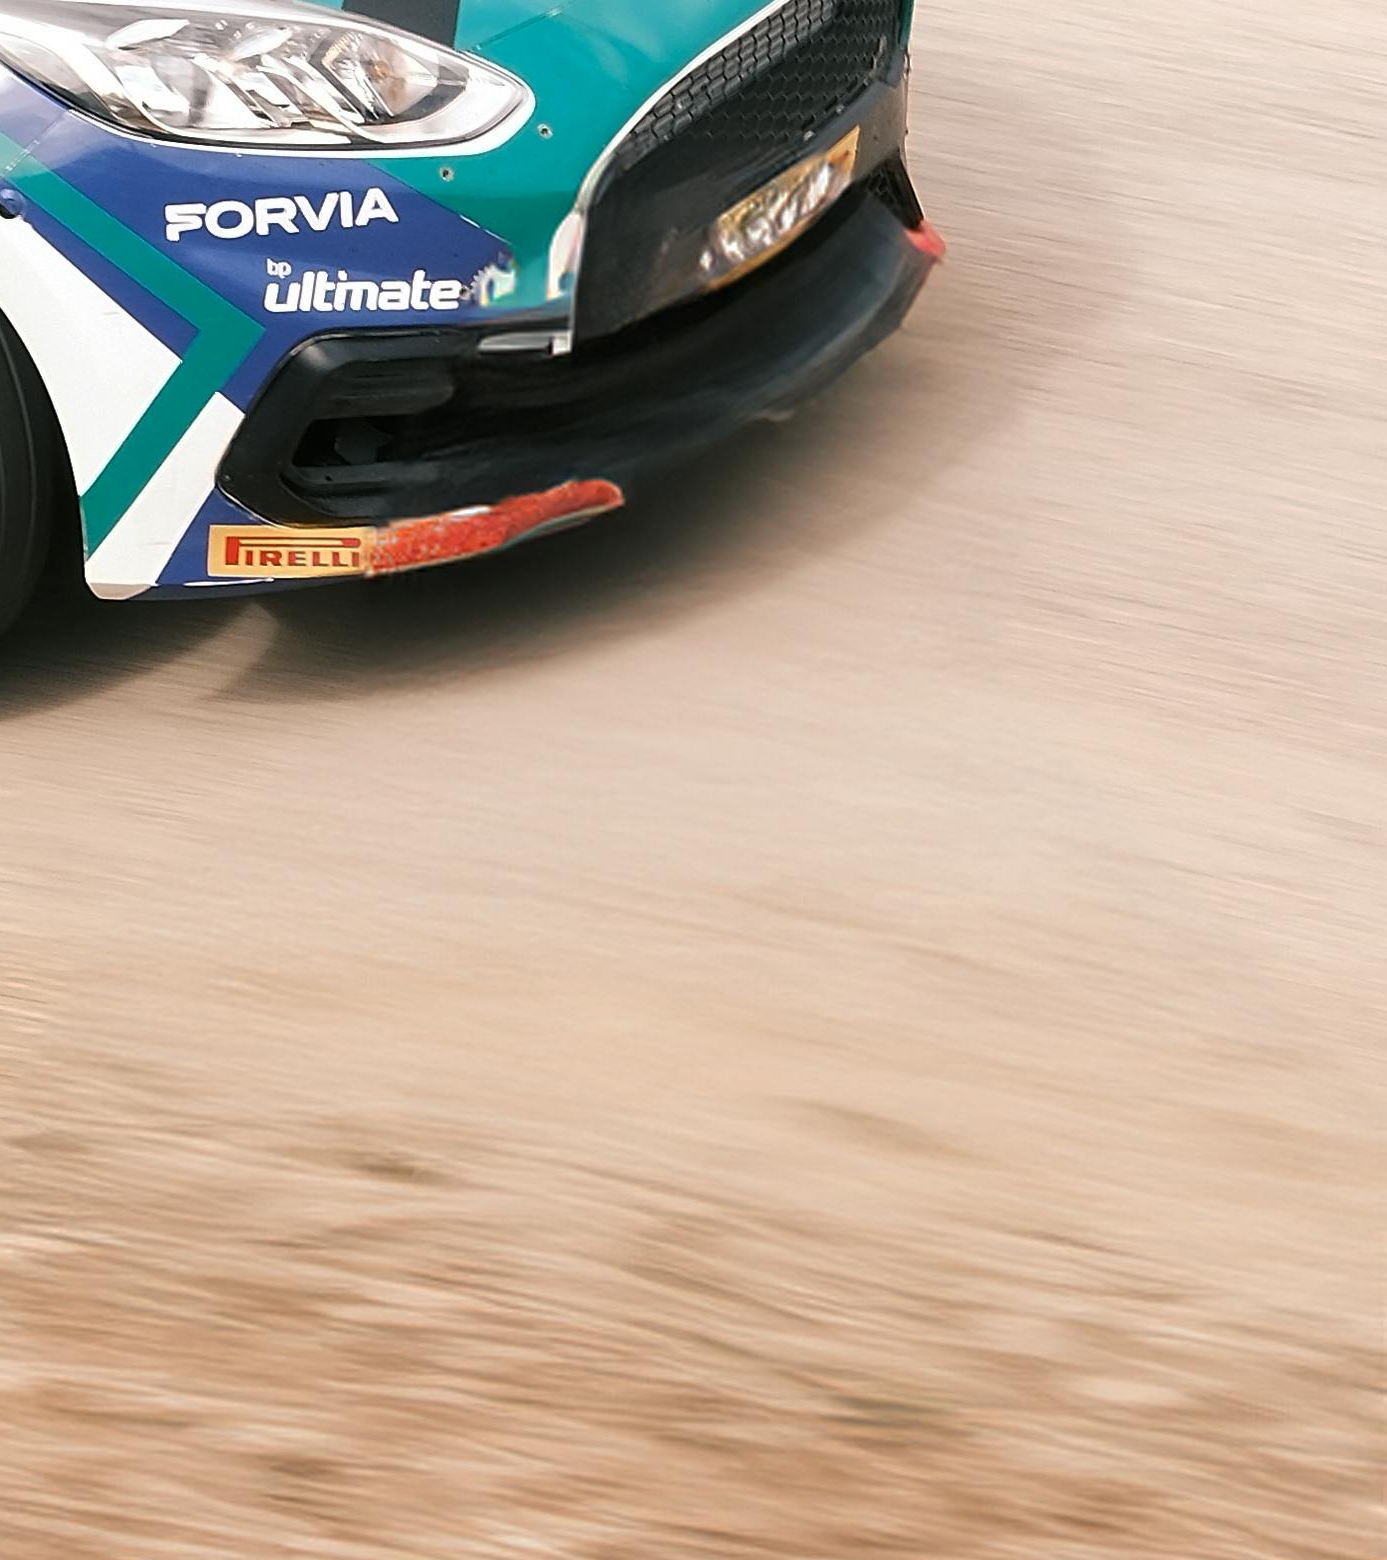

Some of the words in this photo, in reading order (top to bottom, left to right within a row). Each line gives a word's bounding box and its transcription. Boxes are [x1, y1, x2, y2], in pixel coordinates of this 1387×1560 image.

[164, 186, 400, 242] FORVIA
[265, 257, 293, 279] bp
[263, 269, 461, 314] ultimate
[224, 536, 362, 567] PIRELLI
